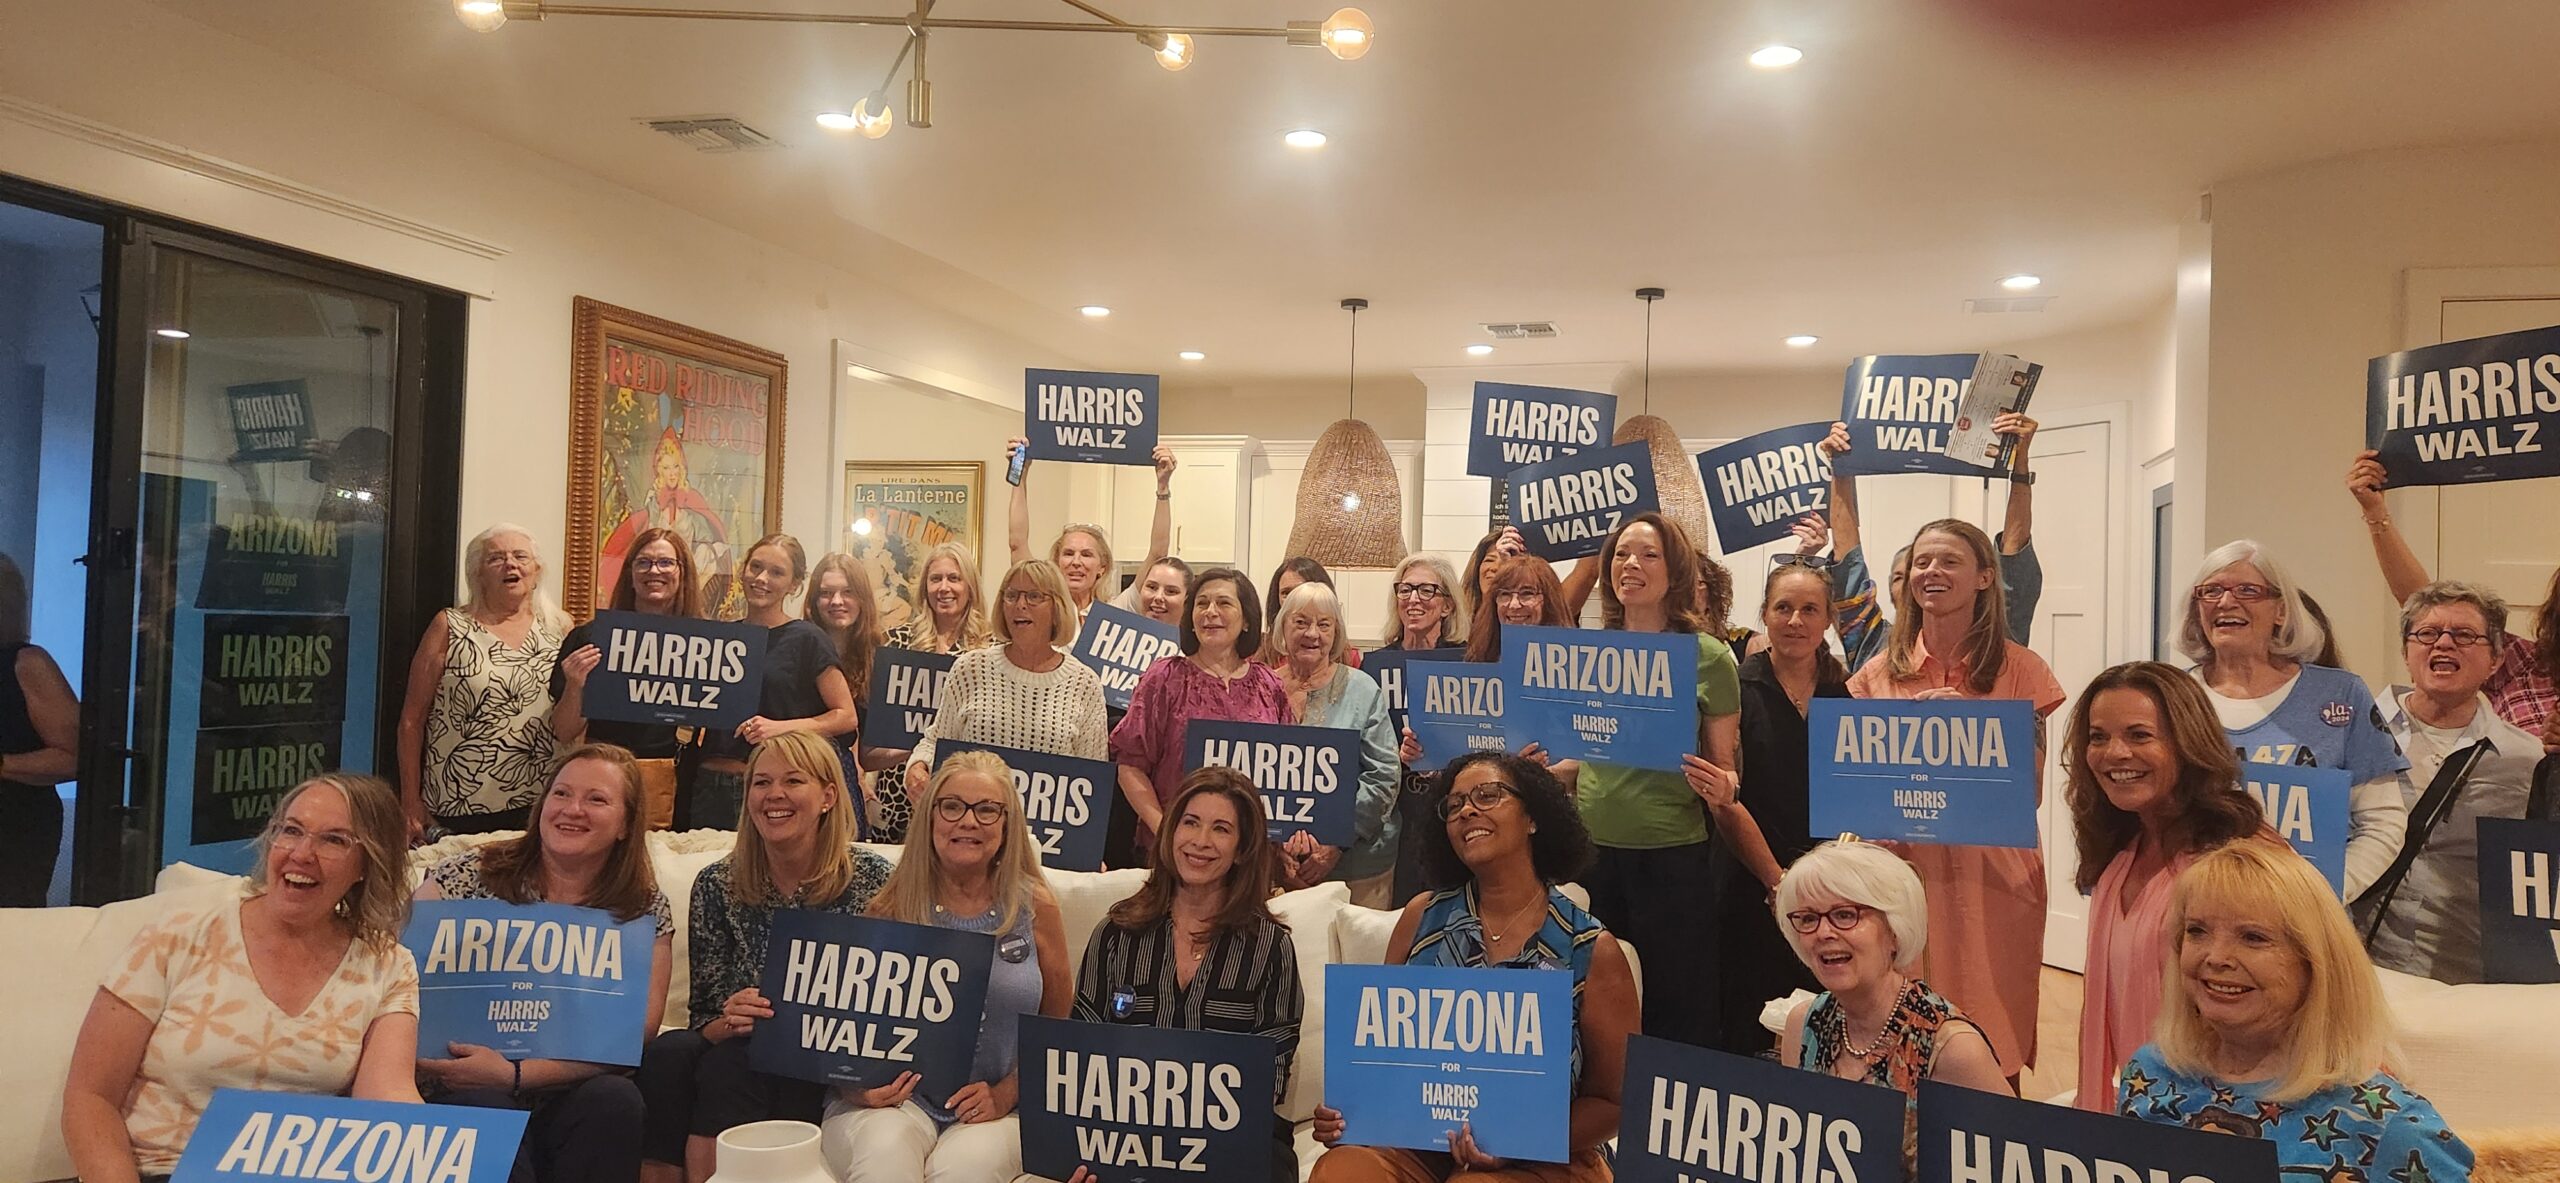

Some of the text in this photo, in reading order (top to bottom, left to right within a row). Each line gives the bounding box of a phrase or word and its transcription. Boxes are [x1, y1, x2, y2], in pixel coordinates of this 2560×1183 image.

[608, 346, 768, 419] RED RIDING
[1856, 375, 1971, 424] HARRI
[2386, 353, 2560, 431] HARRIS
[1038, 383, 1144, 427] HARRIS
[1485, 397, 1600, 446] HARRIS
[682, 404, 767, 456] HOOD
[1055, 425, 1127, 449] WALZ
[1876, 425, 1950, 454] WAL
[2414, 421, 2542, 463] WALZ
[855, 485, 967, 505] La Lanterne
[1520, 461, 1639, 524] HARRIS
[1716, 441, 1833, 508] HARRIS
[1542, 510, 1622, 545] WALZ
[1746, 487, 1828, 527] WALZ
[226, 512, 338, 558] ARIZONA
[262, 572, 298, 587] HARRIS
[220, 634, 334, 678] HARRIS
[607, 628, 747, 684] HARRIS
[1088, 619, 1182, 673] HAR
[886, 664, 950, 710] HAR
[1101, 664, 1140, 692] WA
[1522, 641, 1673, 699] ARIZONA
[238, 682, 313, 706] WALZ
[628, 678, 721, 710] WALZ
[1424, 674, 1504, 718] ARIZO
[1587, 700, 1603, 709] FOR
[1467, 734, 1506, 750] HARRIS
[1478, 722, 1492, 730] FOR
[1572, 713, 1619, 735] HARRIS
[1580, 731, 1612, 744] WALZ
[1834, 715, 2009, 768] ARIZONA
[213, 742, 326, 793] HARRIS
[1203, 739, 1339, 794] HARRIS
[1910, 773, 1929, 782] FOR
[231, 792, 283, 820] WA
[1009, 768, 1093, 827] RRIS
[1260, 794, 1315, 823] ALZ
[1893, 789, 1947, 809] HARRIS
[1902, 808, 1939, 820] WALZ
[424, 918, 623, 980] ARIZONA
[512, 981, 534, 991] FOR
[782, 938, 961, 1024] HARRIS
[487, 999, 551, 1021] HARRIS
[496, 1020, 539, 1033] WALZ
[1354, 986, 1544, 1056] ARIZONA
[800, 1013, 920, 1063] WALZ
[1441, 1062, 1461, 1073] FOR
[1046, 1048, 1244, 1132] HARRIS
[1422, 1082, 1479, 1109] HARRIS
[1431, 1107, 1470, 1122] WALZ
[1648, 1076, 1862, 1183] HARRIS
[216, 1112, 478, 1183] ARIZONA
[1075, 1127, 1208, 1172] WALZ
